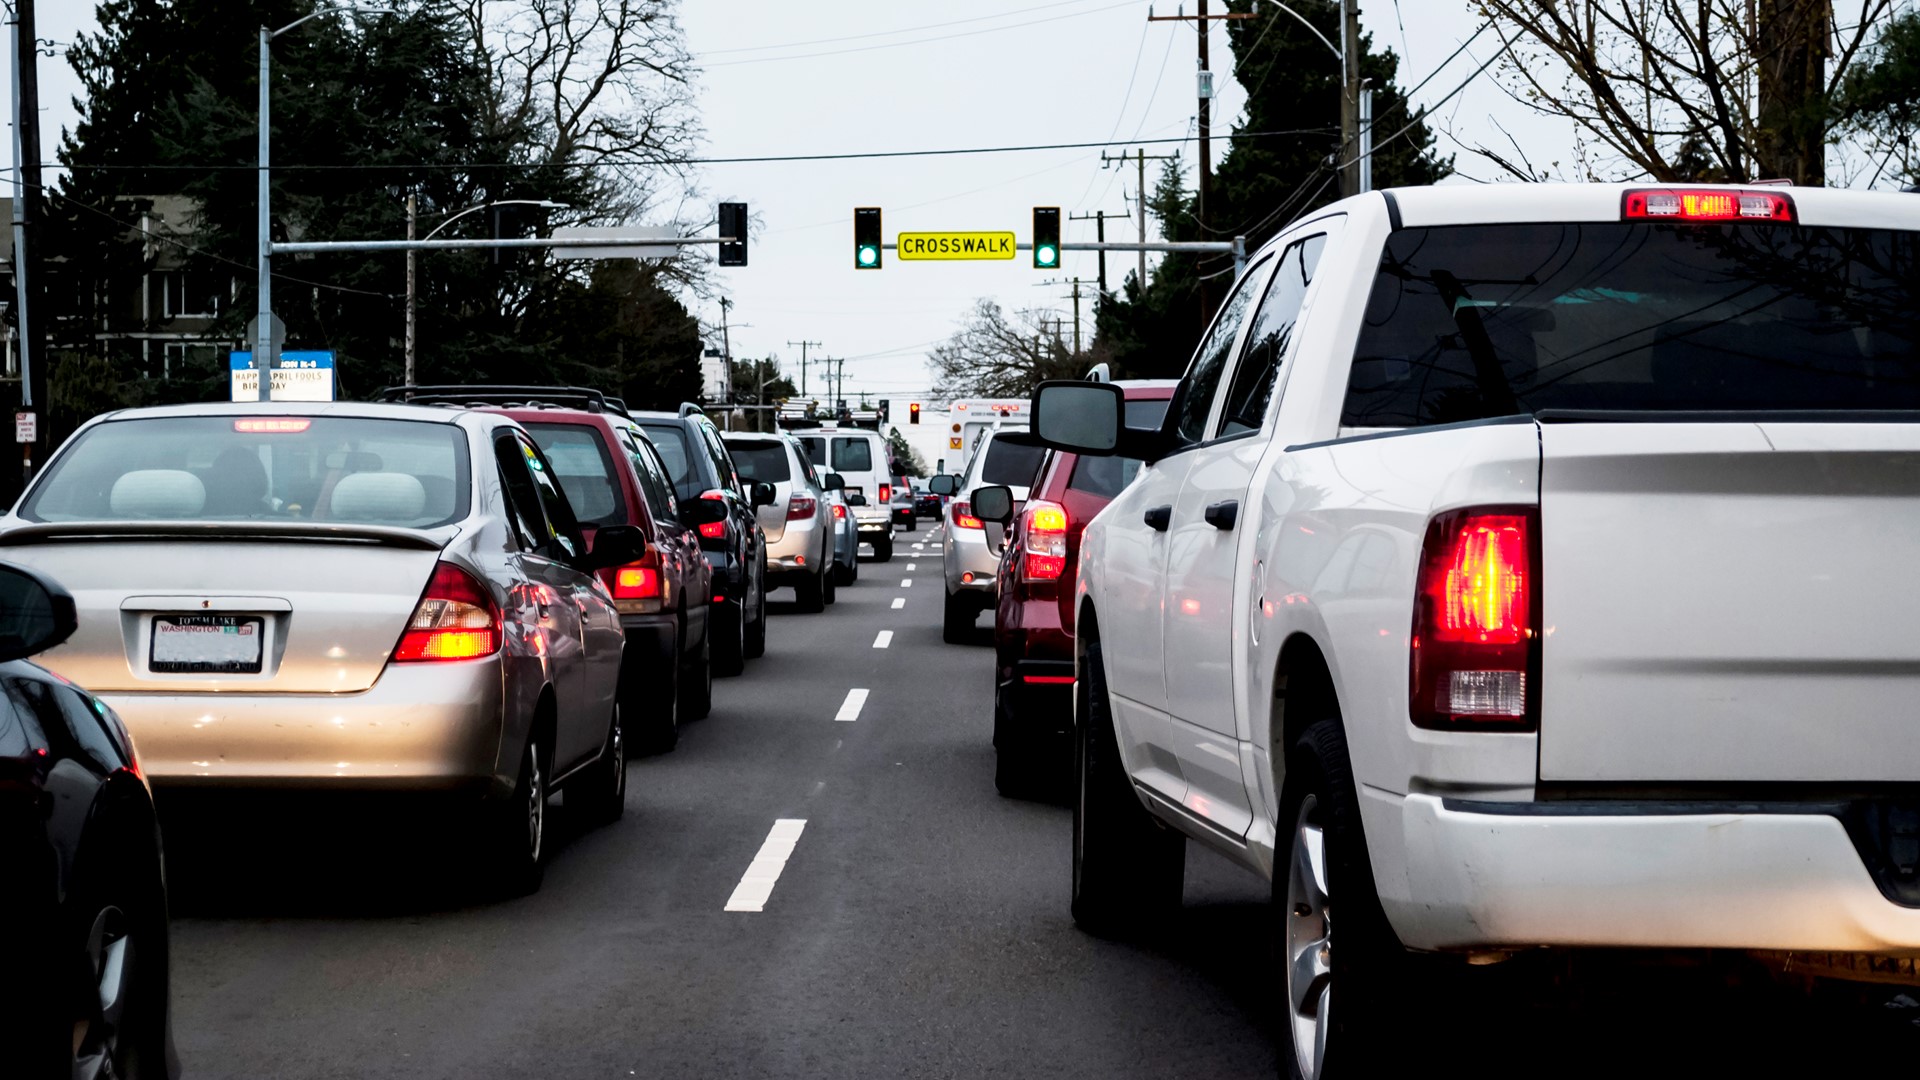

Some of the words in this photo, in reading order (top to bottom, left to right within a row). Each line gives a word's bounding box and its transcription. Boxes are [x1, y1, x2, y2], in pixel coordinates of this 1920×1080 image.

[903, 238, 1010, 253] CROSSWALK
[235, 372, 258, 381] HAPP
[269, 372, 292, 381] PRIL
[295, 372, 322, 381] FOOLS
[242, 382, 286, 390] BIRDAY
[212, 616, 237, 625] LAKE
[160, 625, 220, 633] WASHINGTON
